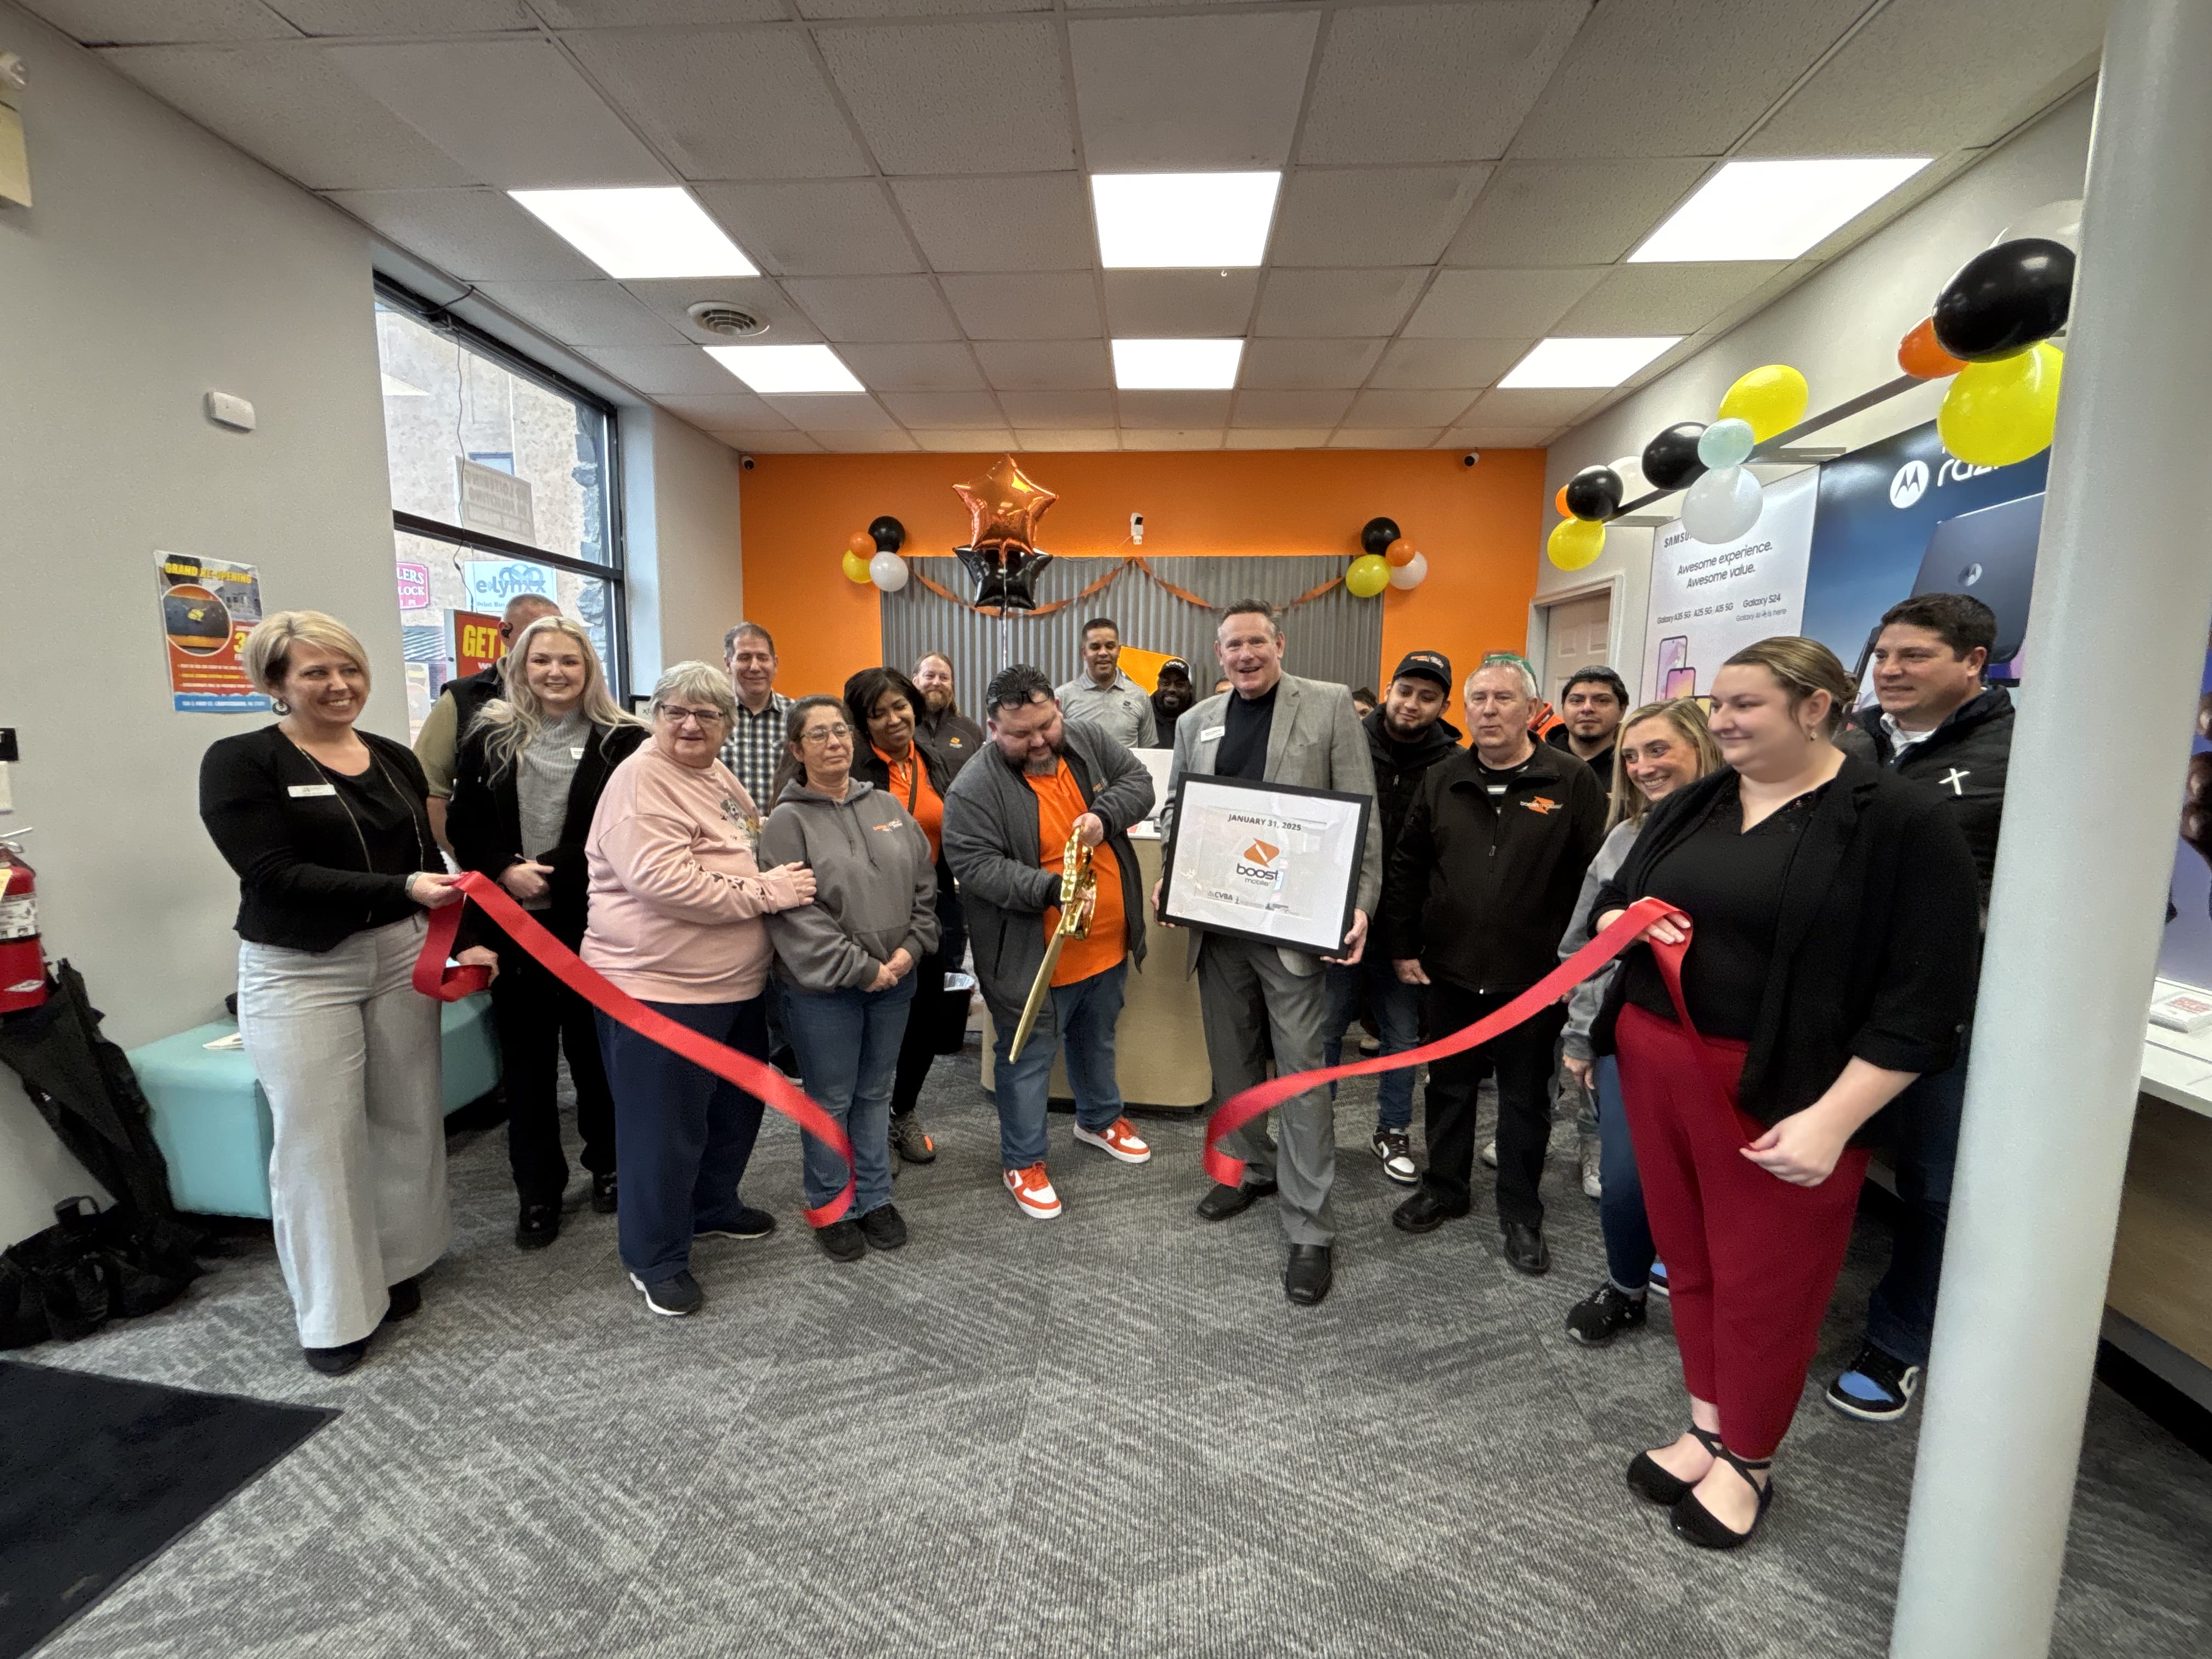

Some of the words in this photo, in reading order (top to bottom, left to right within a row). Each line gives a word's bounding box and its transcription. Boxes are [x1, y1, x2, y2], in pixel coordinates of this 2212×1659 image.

[1664, 531, 1692, 548] SAMSU
[1677, 556, 1717, 575] Awesome
[1719, 540, 1773, 566] experience.
[165, 562, 199, 576] GRAND
[1686, 570, 1728, 589] Awesome
[1729, 563, 1756, 579] value.
[1743, 597, 1768, 608] Galaxy
[1768, 593, 1781, 603] S24
[1657, 615, 1674, 624] Galaxy
[1694, 608, 1703, 617] A25
[1704, 607, 1712, 615] 5G
[1725, 602, 1734, 611] 5G
[462, 624, 498, 659] GET
[1228, 814, 1266, 826] JANUARY
[1267, 820, 1279, 829] 31,
[1282, 822, 1301, 831] 2025
[1237, 863, 1278, 881] boost
[1245, 878, 1269, 887] mobile
[1215, 891, 1233, 901] CVBA
